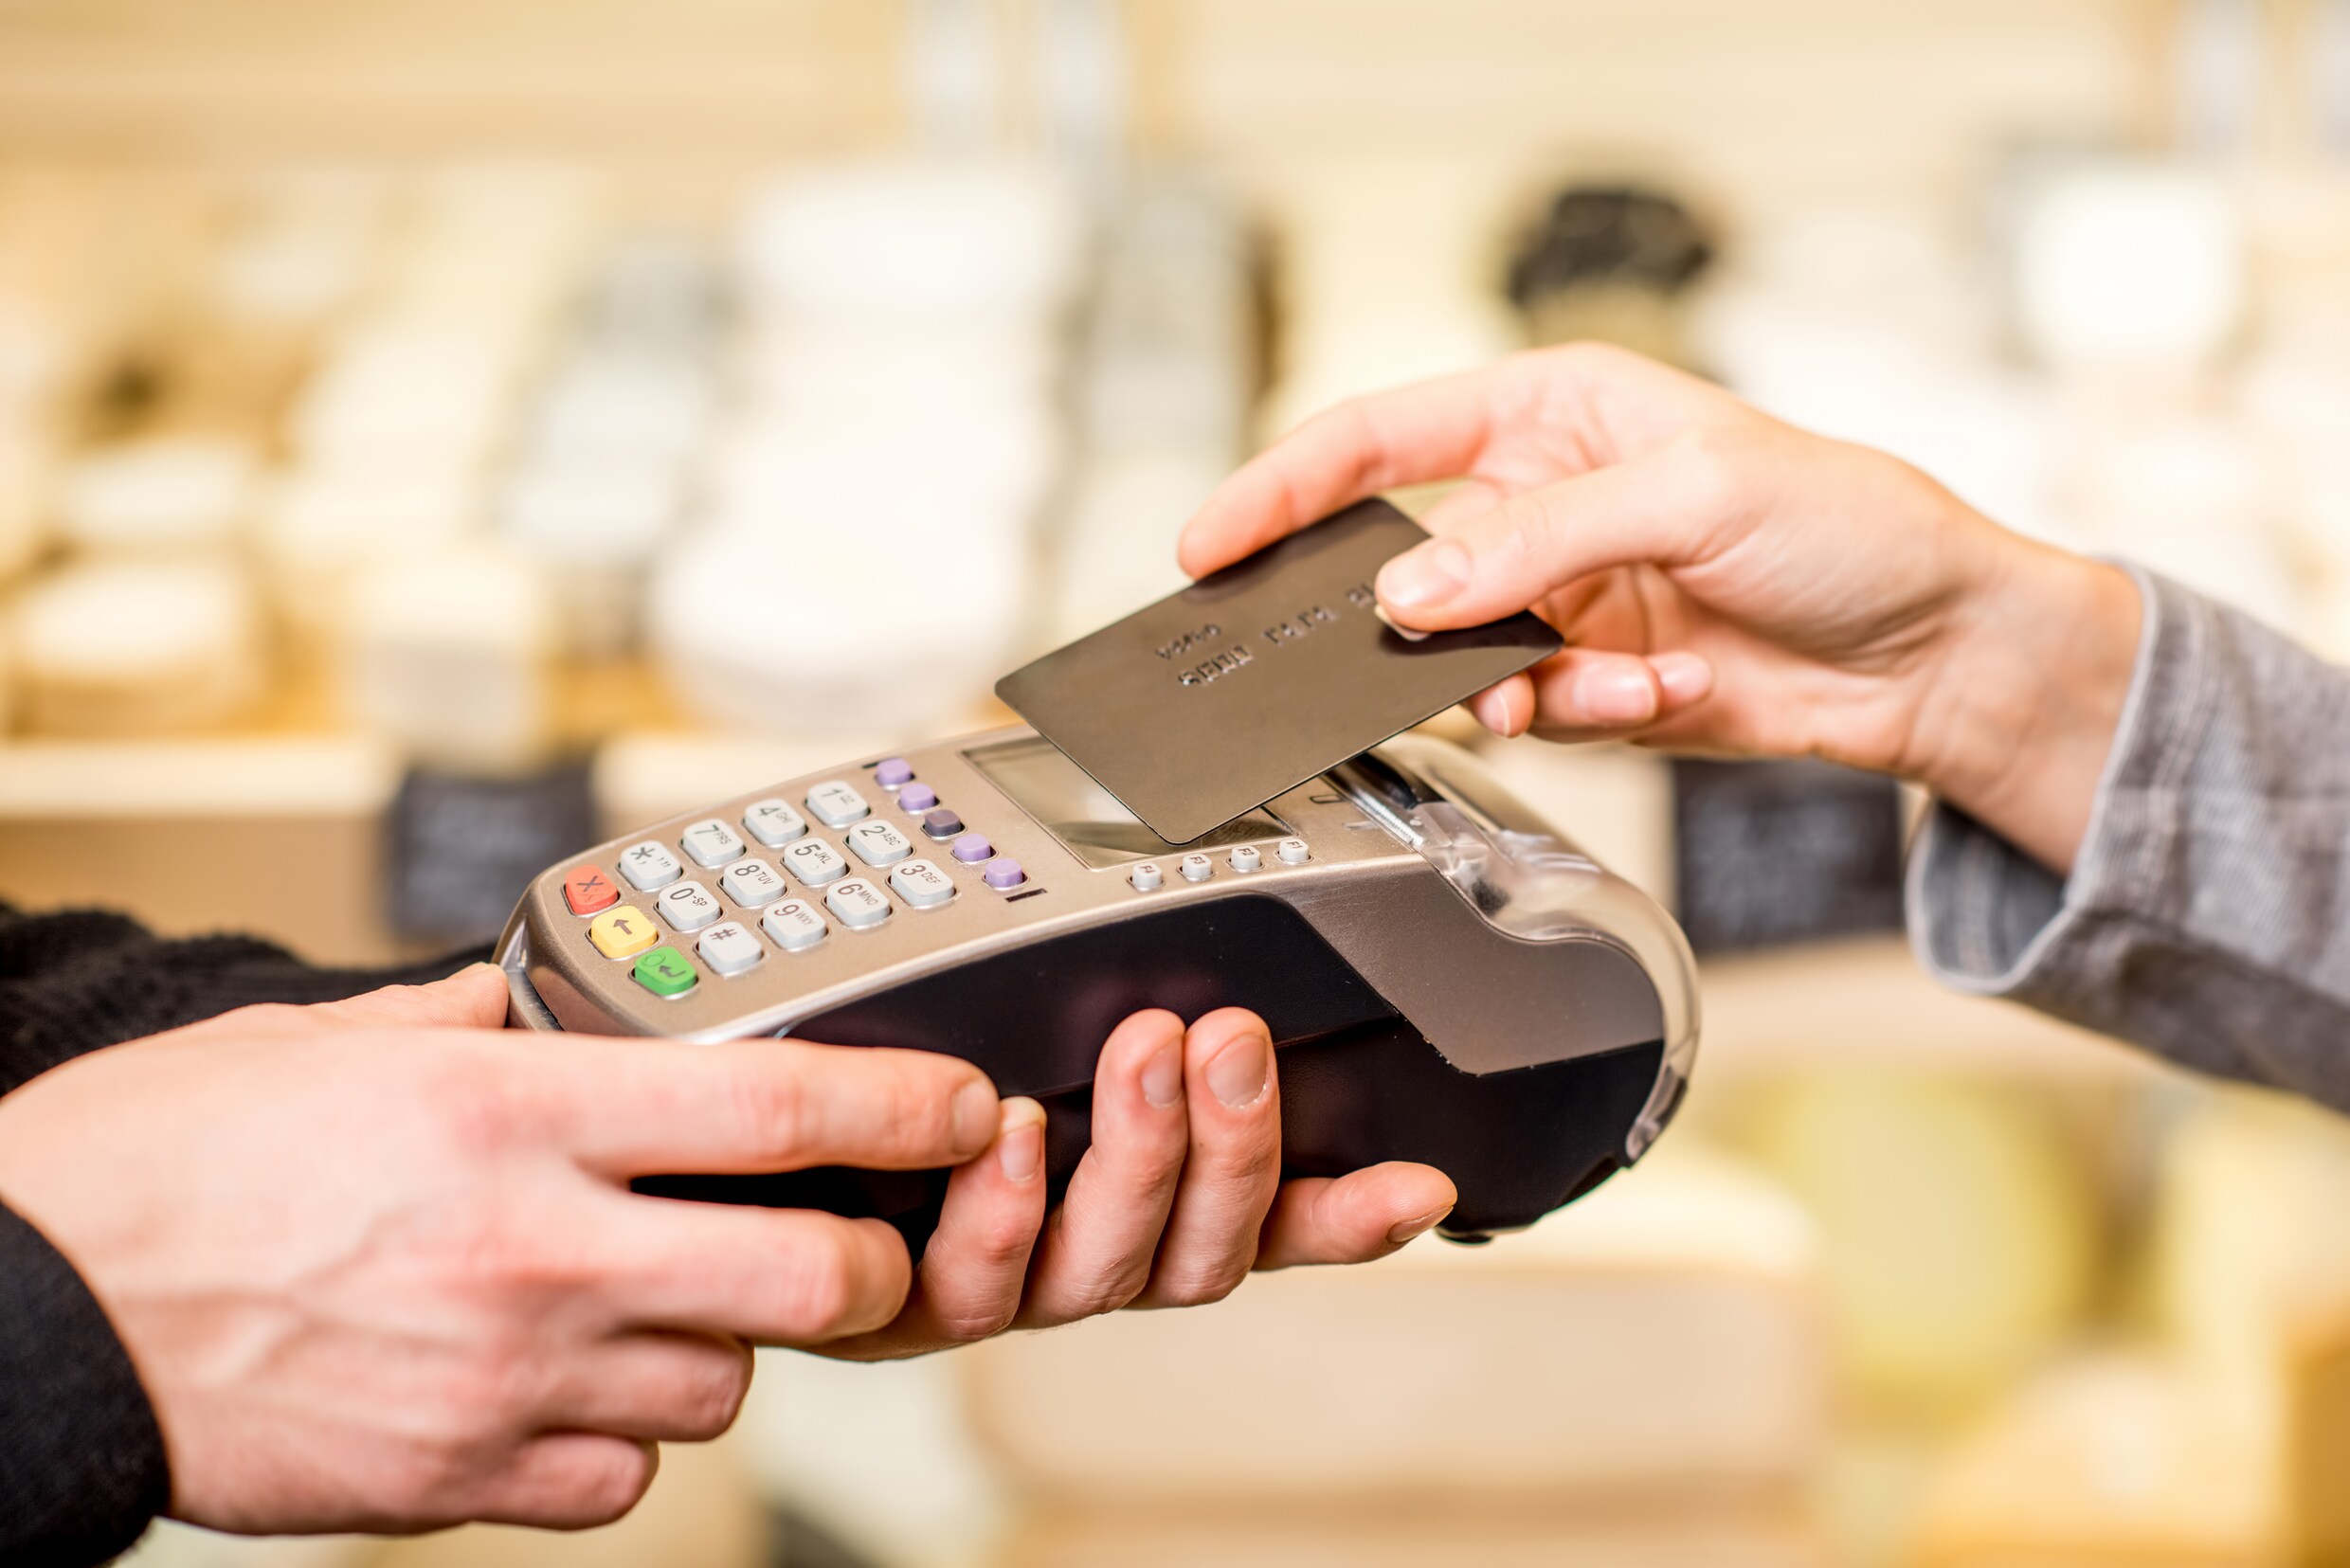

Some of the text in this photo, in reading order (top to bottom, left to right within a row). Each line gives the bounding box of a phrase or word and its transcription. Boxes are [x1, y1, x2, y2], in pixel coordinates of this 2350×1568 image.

[758, 806, 782, 817] 4
[694, 824, 719, 835] 7
[859, 825, 901, 847] 2 ABC
[794, 843, 833, 864] 5 JKL
[1238, 847, 1255, 856] F2
[1189, 856, 1206, 865] F3
[734, 864, 775, 885] 8 TUV
[900, 864, 941, 885] 3 DEF
[669, 888, 695, 900] 0
[838, 883, 878, 906] 6 MNO
[773, 904, 816, 926] 9 WXY
[709, 928, 737, 940] #
